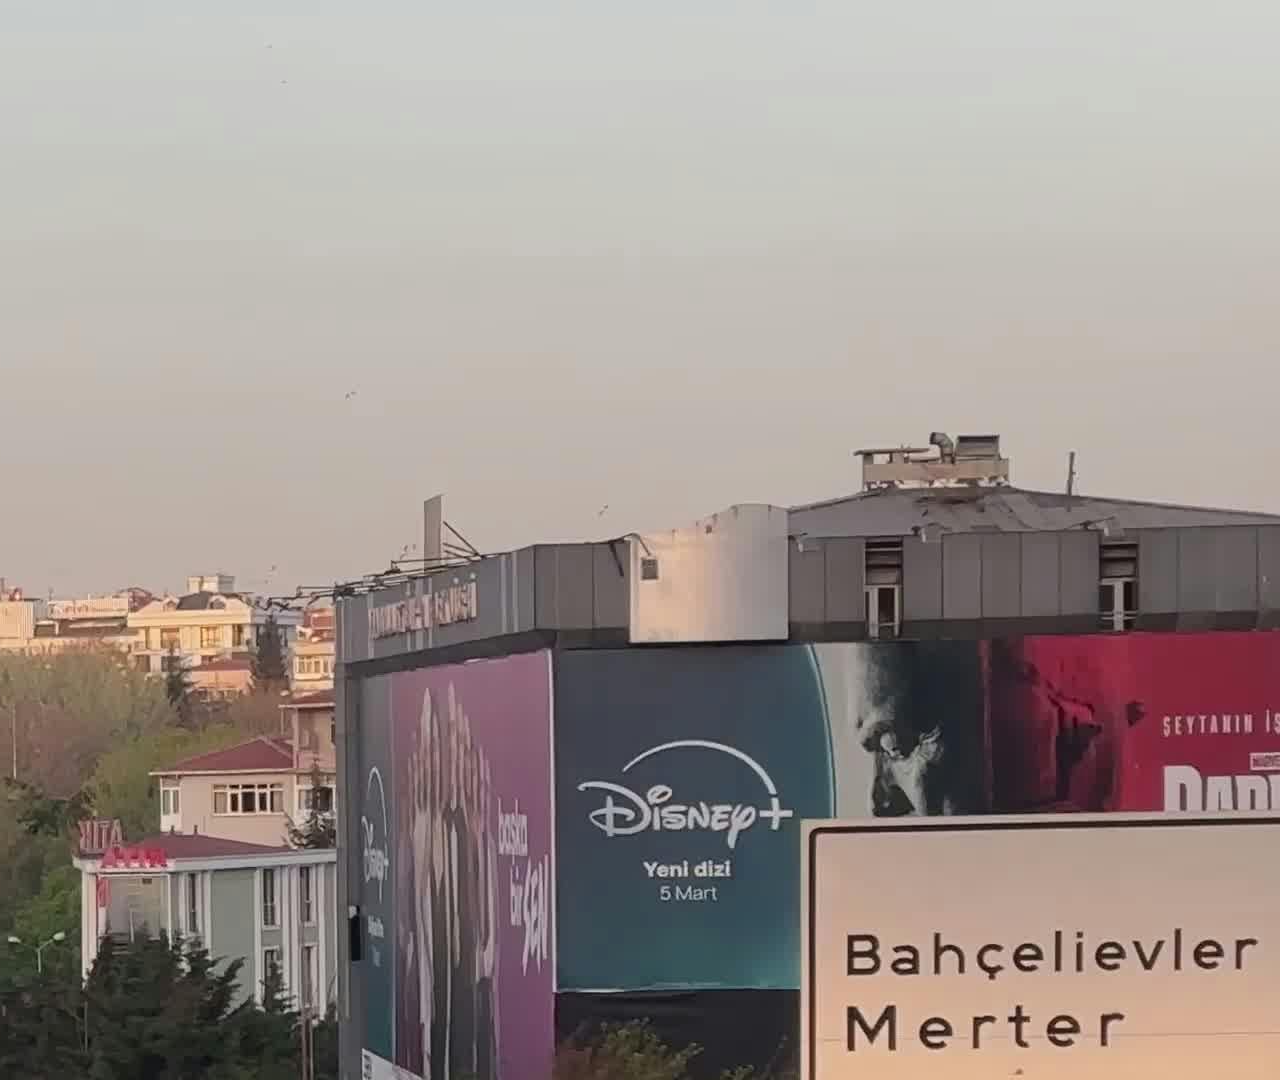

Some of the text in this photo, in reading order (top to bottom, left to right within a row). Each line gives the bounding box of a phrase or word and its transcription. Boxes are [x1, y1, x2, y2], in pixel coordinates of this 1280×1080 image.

[577, 784, 794, 849] Disney+
[643, 860, 732, 878] Yeni dizi
[660, 885, 718, 902] 5 Mart
[846, 928, 1259, 980] Bahçelievler
[847, 1005, 1126, 1052] Merter
